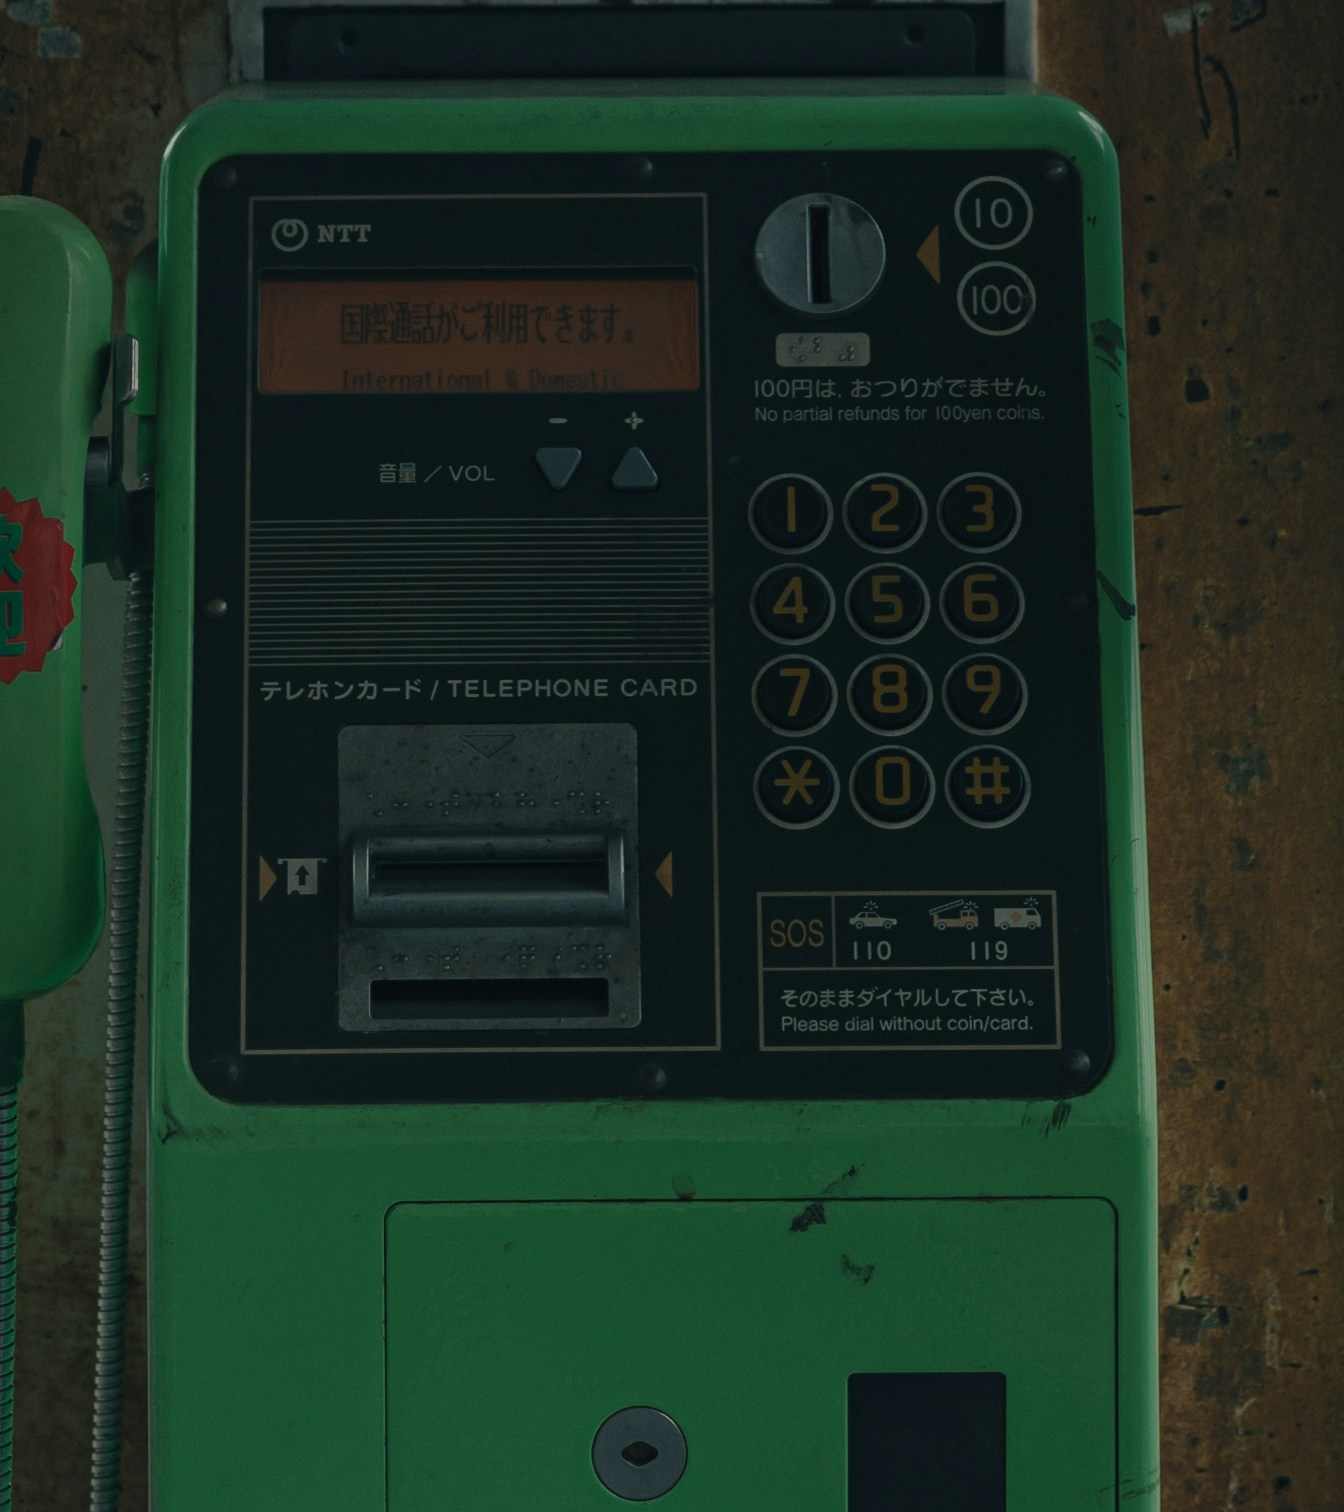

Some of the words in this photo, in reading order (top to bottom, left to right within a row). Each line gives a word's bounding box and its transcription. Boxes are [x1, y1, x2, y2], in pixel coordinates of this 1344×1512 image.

[975, 197, 1013, 229] 10
[317, 223, 372, 244] NTT
[971, 284, 1023, 315] 100
[340, 301, 636, 346] 国際通話がご利用できます。
[342, 368, 491, 391] International
[529, 368, 624, 391] Domestic
[755, 406, 778, 422] No
[783, 405, 833, 423] partial
[838, 405, 900, 421] refunds
[904, 405, 927, 421] for
[936, 405, 992, 422] 100yen
[997, 405, 1045, 421] coins.
[378, 463, 418, 485] 音量
[448, 465, 496, 483] VOL
[787, 486, 796, 532] 1
[870, 484, 900, 532] 2
[965, 484, 995, 532] 3
[773, 576, 808, 624] 4
[871, 574, 902, 623] 5
[965, 574, 998, 623] 6
[259, 679, 422, 702] テレホンカード
[447, 678, 609, 698] TELEPHONE
[620, 677, 698, 698] CARD
[779, 667, 810, 716] 7
[873, 664, 909, 714] 8
[965, 664, 1002, 716] 9
[877, 757, 912, 806] 0
[770, 918, 825, 948] SOS
[853, 941, 892, 961] 110
[971, 941, 1008, 961] 119
[780, 988, 1035, 1009] そのままダイヤルして下さい。
[781, 1016, 839, 1032] Please
[845, 1016, 874, 1032] dial
[880, 1016, 942, 1031] without
[947, 1015, 1033, 1032] coin/card.
